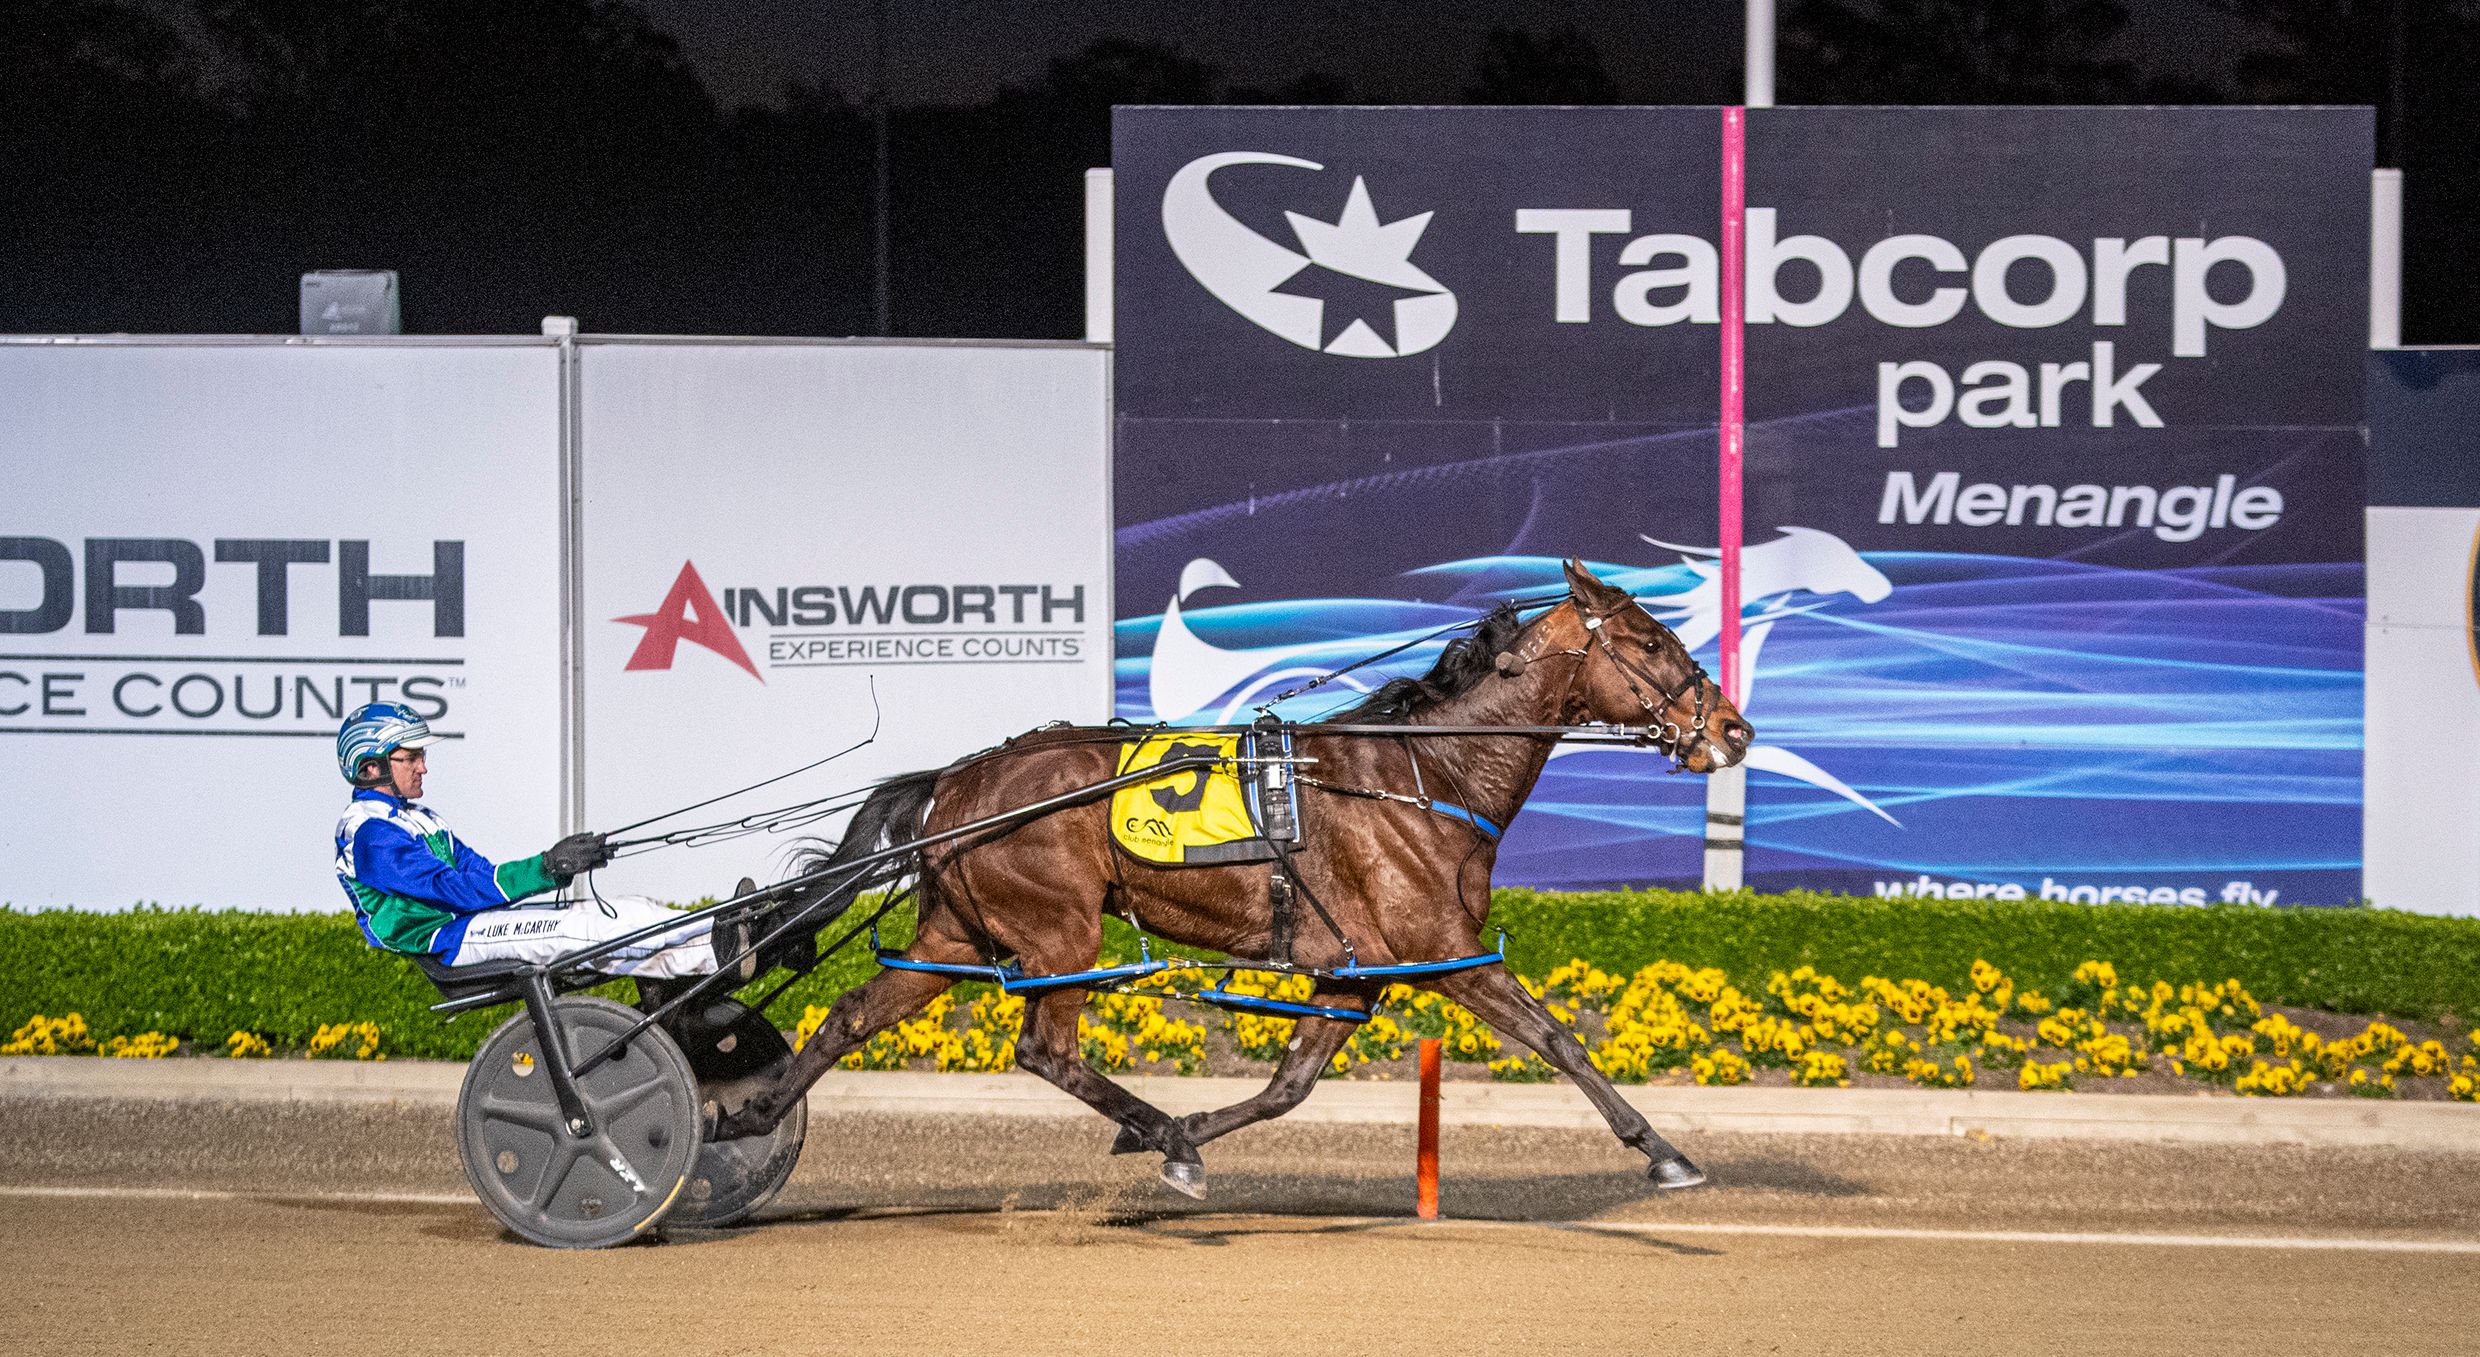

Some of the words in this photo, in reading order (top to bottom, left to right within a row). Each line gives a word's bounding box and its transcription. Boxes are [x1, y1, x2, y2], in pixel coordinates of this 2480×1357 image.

[1516, 207, 2287, 357] Tabcorp
[1877, 341, 2165, 449] park
[1878, 470, 2285, 543] Menangle
[609, 558, 1085, 686] AINSWORTH
[769, 639, 952, 661] EXPERIENCE
[962, 637, 1080, 658] COUNTS
[1873, 874, 2026, 901] where
[2040, 877, 2206, 908] horses
[486, 922, 509, 938] LUKE
